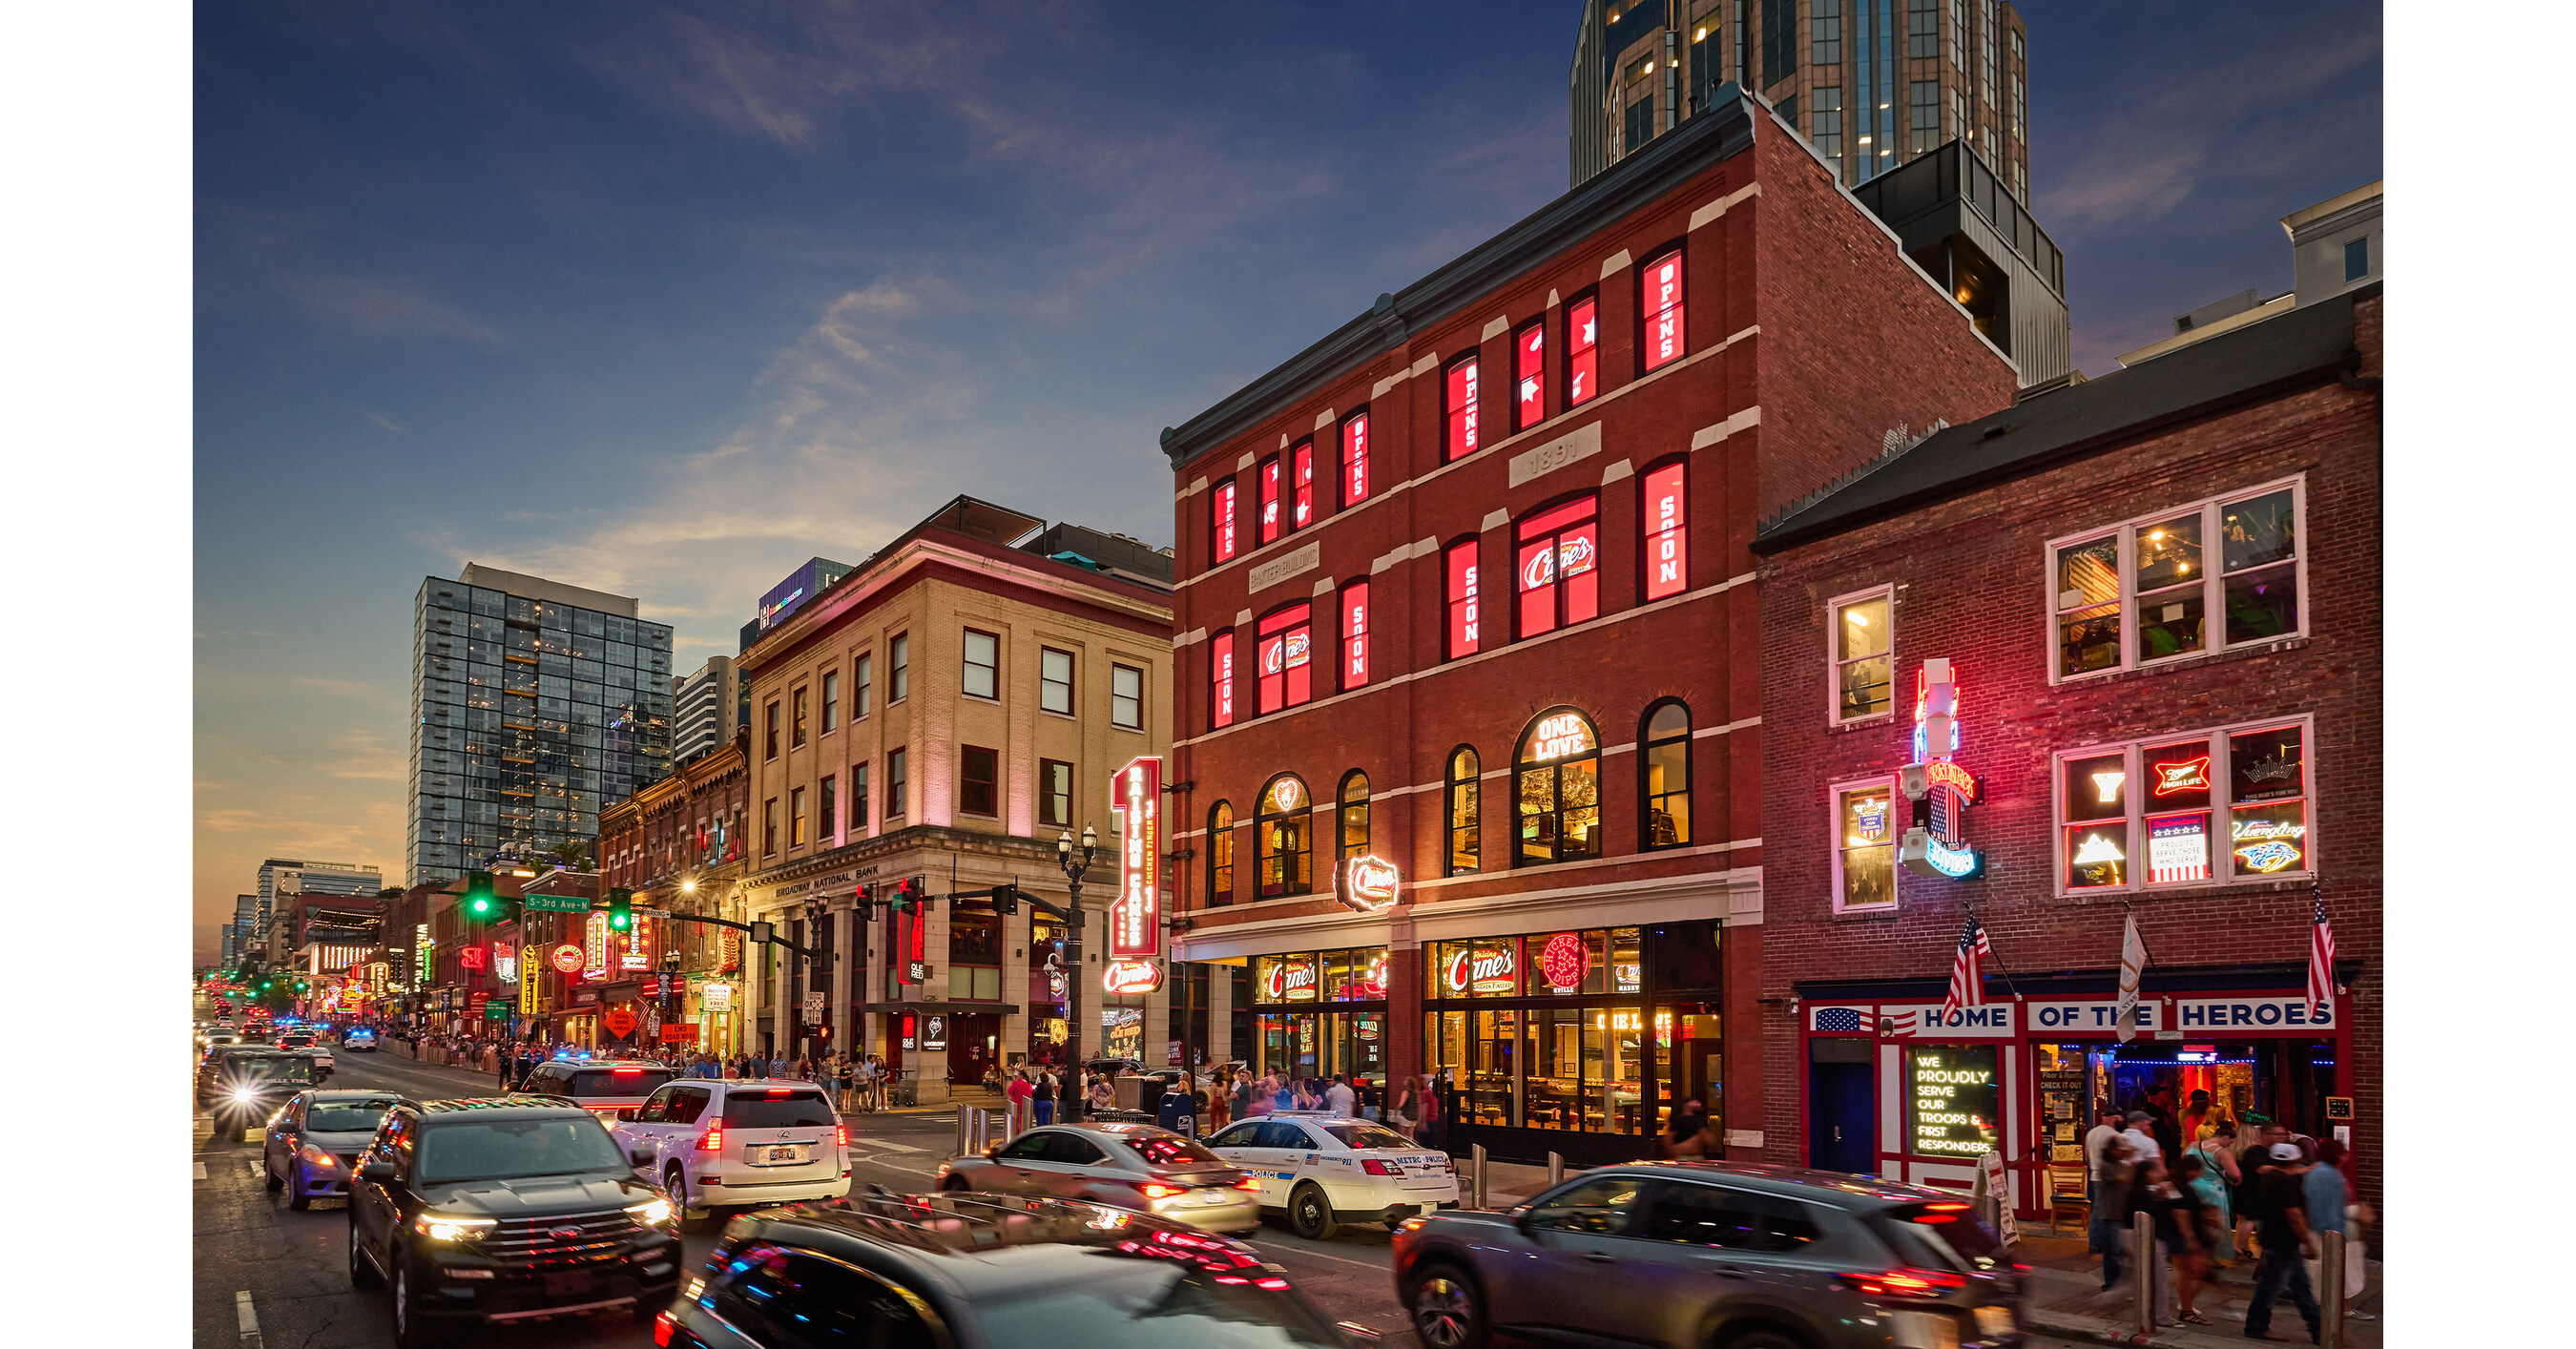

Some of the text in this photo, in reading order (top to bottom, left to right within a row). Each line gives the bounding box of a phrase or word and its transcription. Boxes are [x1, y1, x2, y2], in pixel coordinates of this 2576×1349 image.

[1660, 263, 1673, 359] OPENS
[1465, 364, 1477, 447] OPENS
[1353, 421, 1363, 496] OPENS
[1529, 441, 1577, 474] 1891
[1225, 486, 1235, 553] OPENS
[1660, 495, 1677, 583] SOON
[1250, 548, 1318, 589] BAXTER BUILDING
[1465, 566, 1478, 642] SOON
[1352, 605, 1364, 675] SOON
[1266, 633, 1310, 674] Cne's
[1222, 653, 1232, 716] SOON
[1538, 714, 1579, 740] ONE
[1534, 733, 1585, 761] LOVE
[2162, 777, 2202, 789] HIGH LIFE
[2165, 765, 2198, 781] Miller
[1129, 766, 1142, 868] RAISING
[2232, 821, 2306, 841] Yuengling
[776, 864, 879, 898] BROADWAY NATIONAL BANK
[530, 897, 588, 910] S-3rd Ave-N
[643, 908, 666, 918] PARKING
[1473, 950, 1498, 960] Raising
[1546, 937, 1579, 973] CHICKEN
[910, 963, 924, 971] OLE
[910, 971, 924, 980] RED
[1104, 961, 1155, 992] Cane's
[1286, 964, 1305, 972] Raising
[1449, 948, 1514, 991] Cane's
[1553, 965, 1580, 986] DIPP
[1269, 962, 1316, 998] Cane's
[1631, 1013, 1672, 1029] LVE
[1924, 1007, 2007, 1027] HOME
[2038, 1006, 2081, 1027] OF
[2182, 1003, 2333, 1027] HEROES
[1110, 1026, 1141, 1040] OLE RED
[1917, 1056, 1940, 1068] WE
[1917, 1070, 1990, 1084] PROUDLY
[2041, 1081, 2061, 1090] CHECK
[1917, 1086, 1955, 1097] SERVE
[1917, 1098, 1945, 1110] OUR
[1918, 1111, 1981, 1125] TROOPS &
[1918, 1126, 1947, 1137] FIRST
[1918, 1138, 1991, 1153] RESPONDERS
[1341, 1157, 1352, 1167] 911
[1396, 1155, 1422, 1165] METRO
[1252, 1170, 1279, 1179] POLICE
